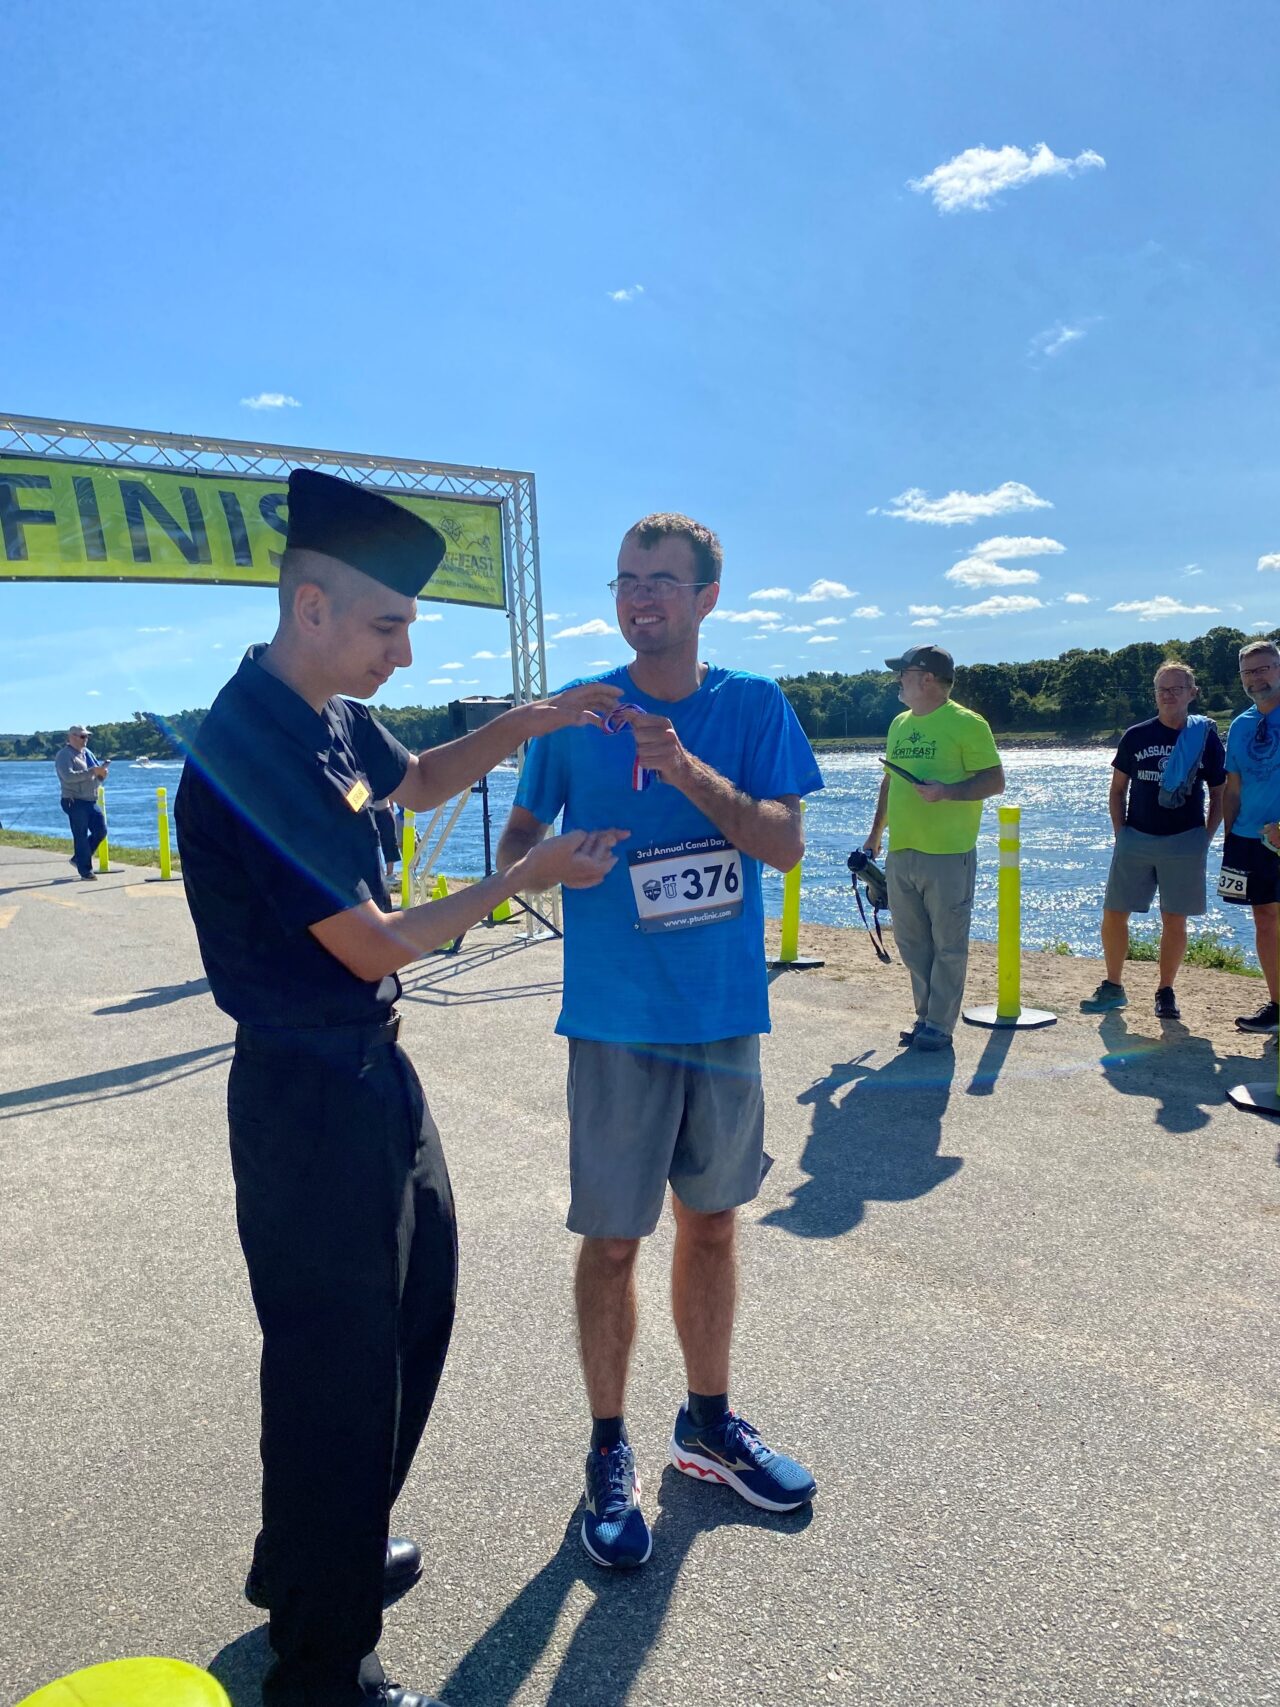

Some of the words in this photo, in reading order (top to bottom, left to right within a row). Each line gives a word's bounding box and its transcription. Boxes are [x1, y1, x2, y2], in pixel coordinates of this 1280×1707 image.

[637, 848, 652, 859] 3rd
[654, 843, 684, 856] Annual
[686, 839, 709, 850] Canal
[711, 839, 726, 847] Day
[662, 874, 677, 884] PT
[680, 862, 739, 900] 376
[1219, 876, 1244, 891] 378
[663, 883, 678, 899] U
[663, 909, 732, 928] www.ptuclinic.com
